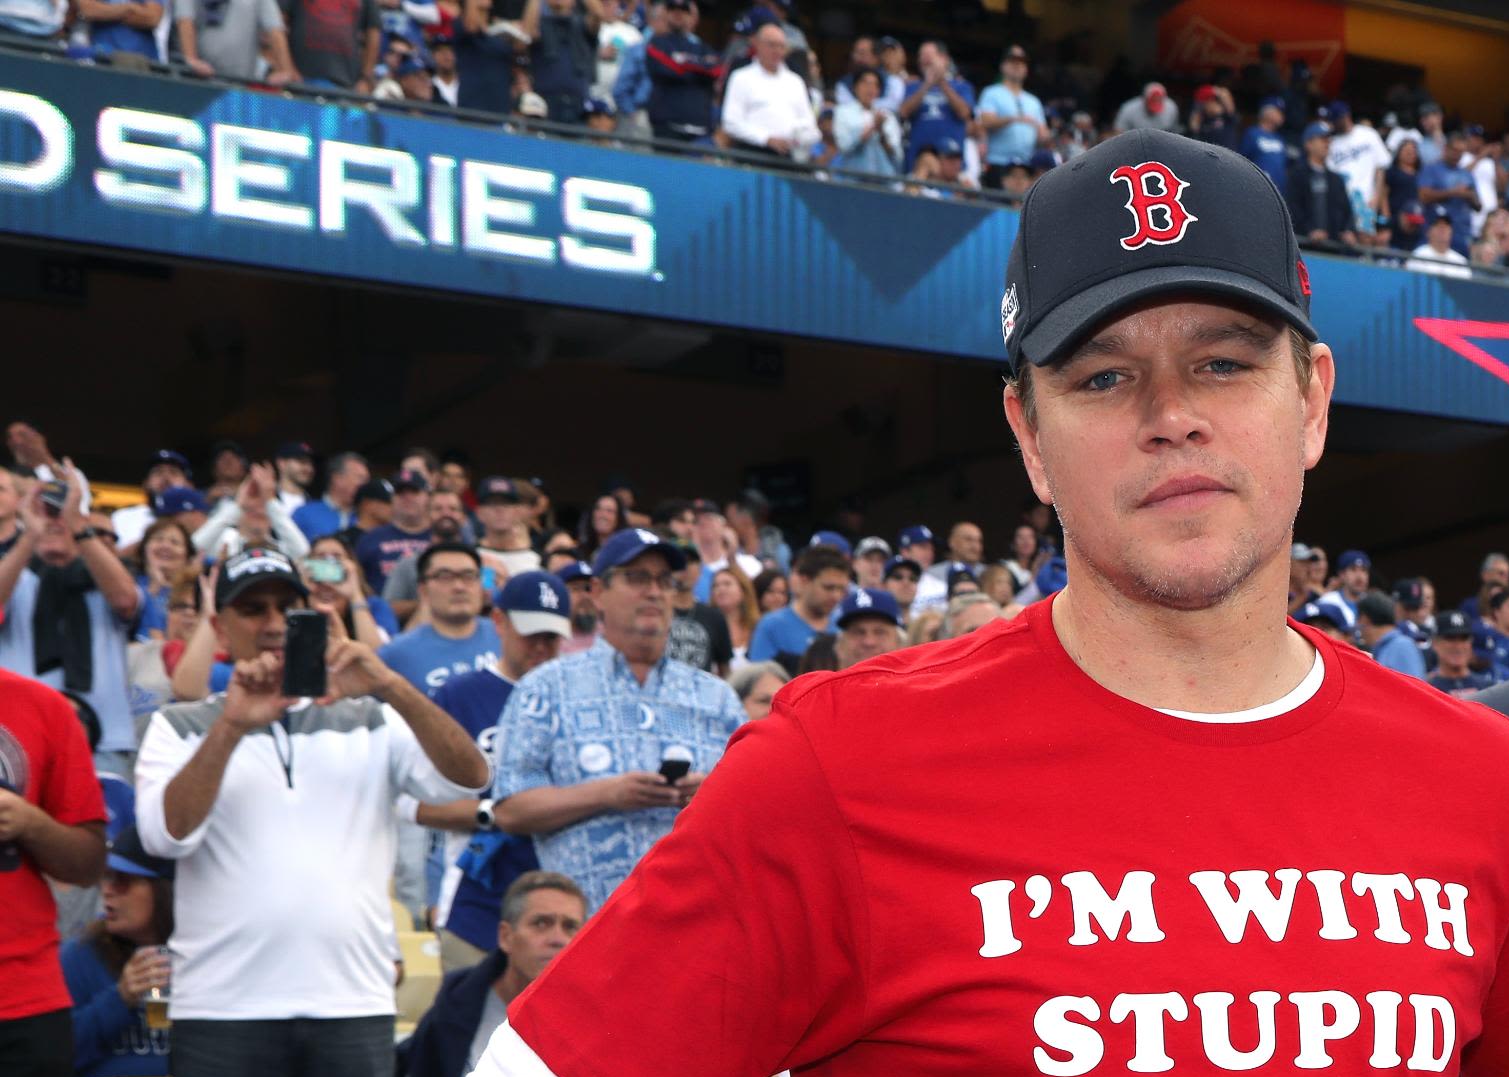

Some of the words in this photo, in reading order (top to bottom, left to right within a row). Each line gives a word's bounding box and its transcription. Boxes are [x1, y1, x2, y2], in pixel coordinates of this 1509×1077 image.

[94, 106, 656, 275] SERIES
[1110, 161, 1198, 250] B
[970, 870, 1166, 958] I'M
[1188, 868, 1475, 957] WITH
[1033, 990, 1456, 1077] STUPID
